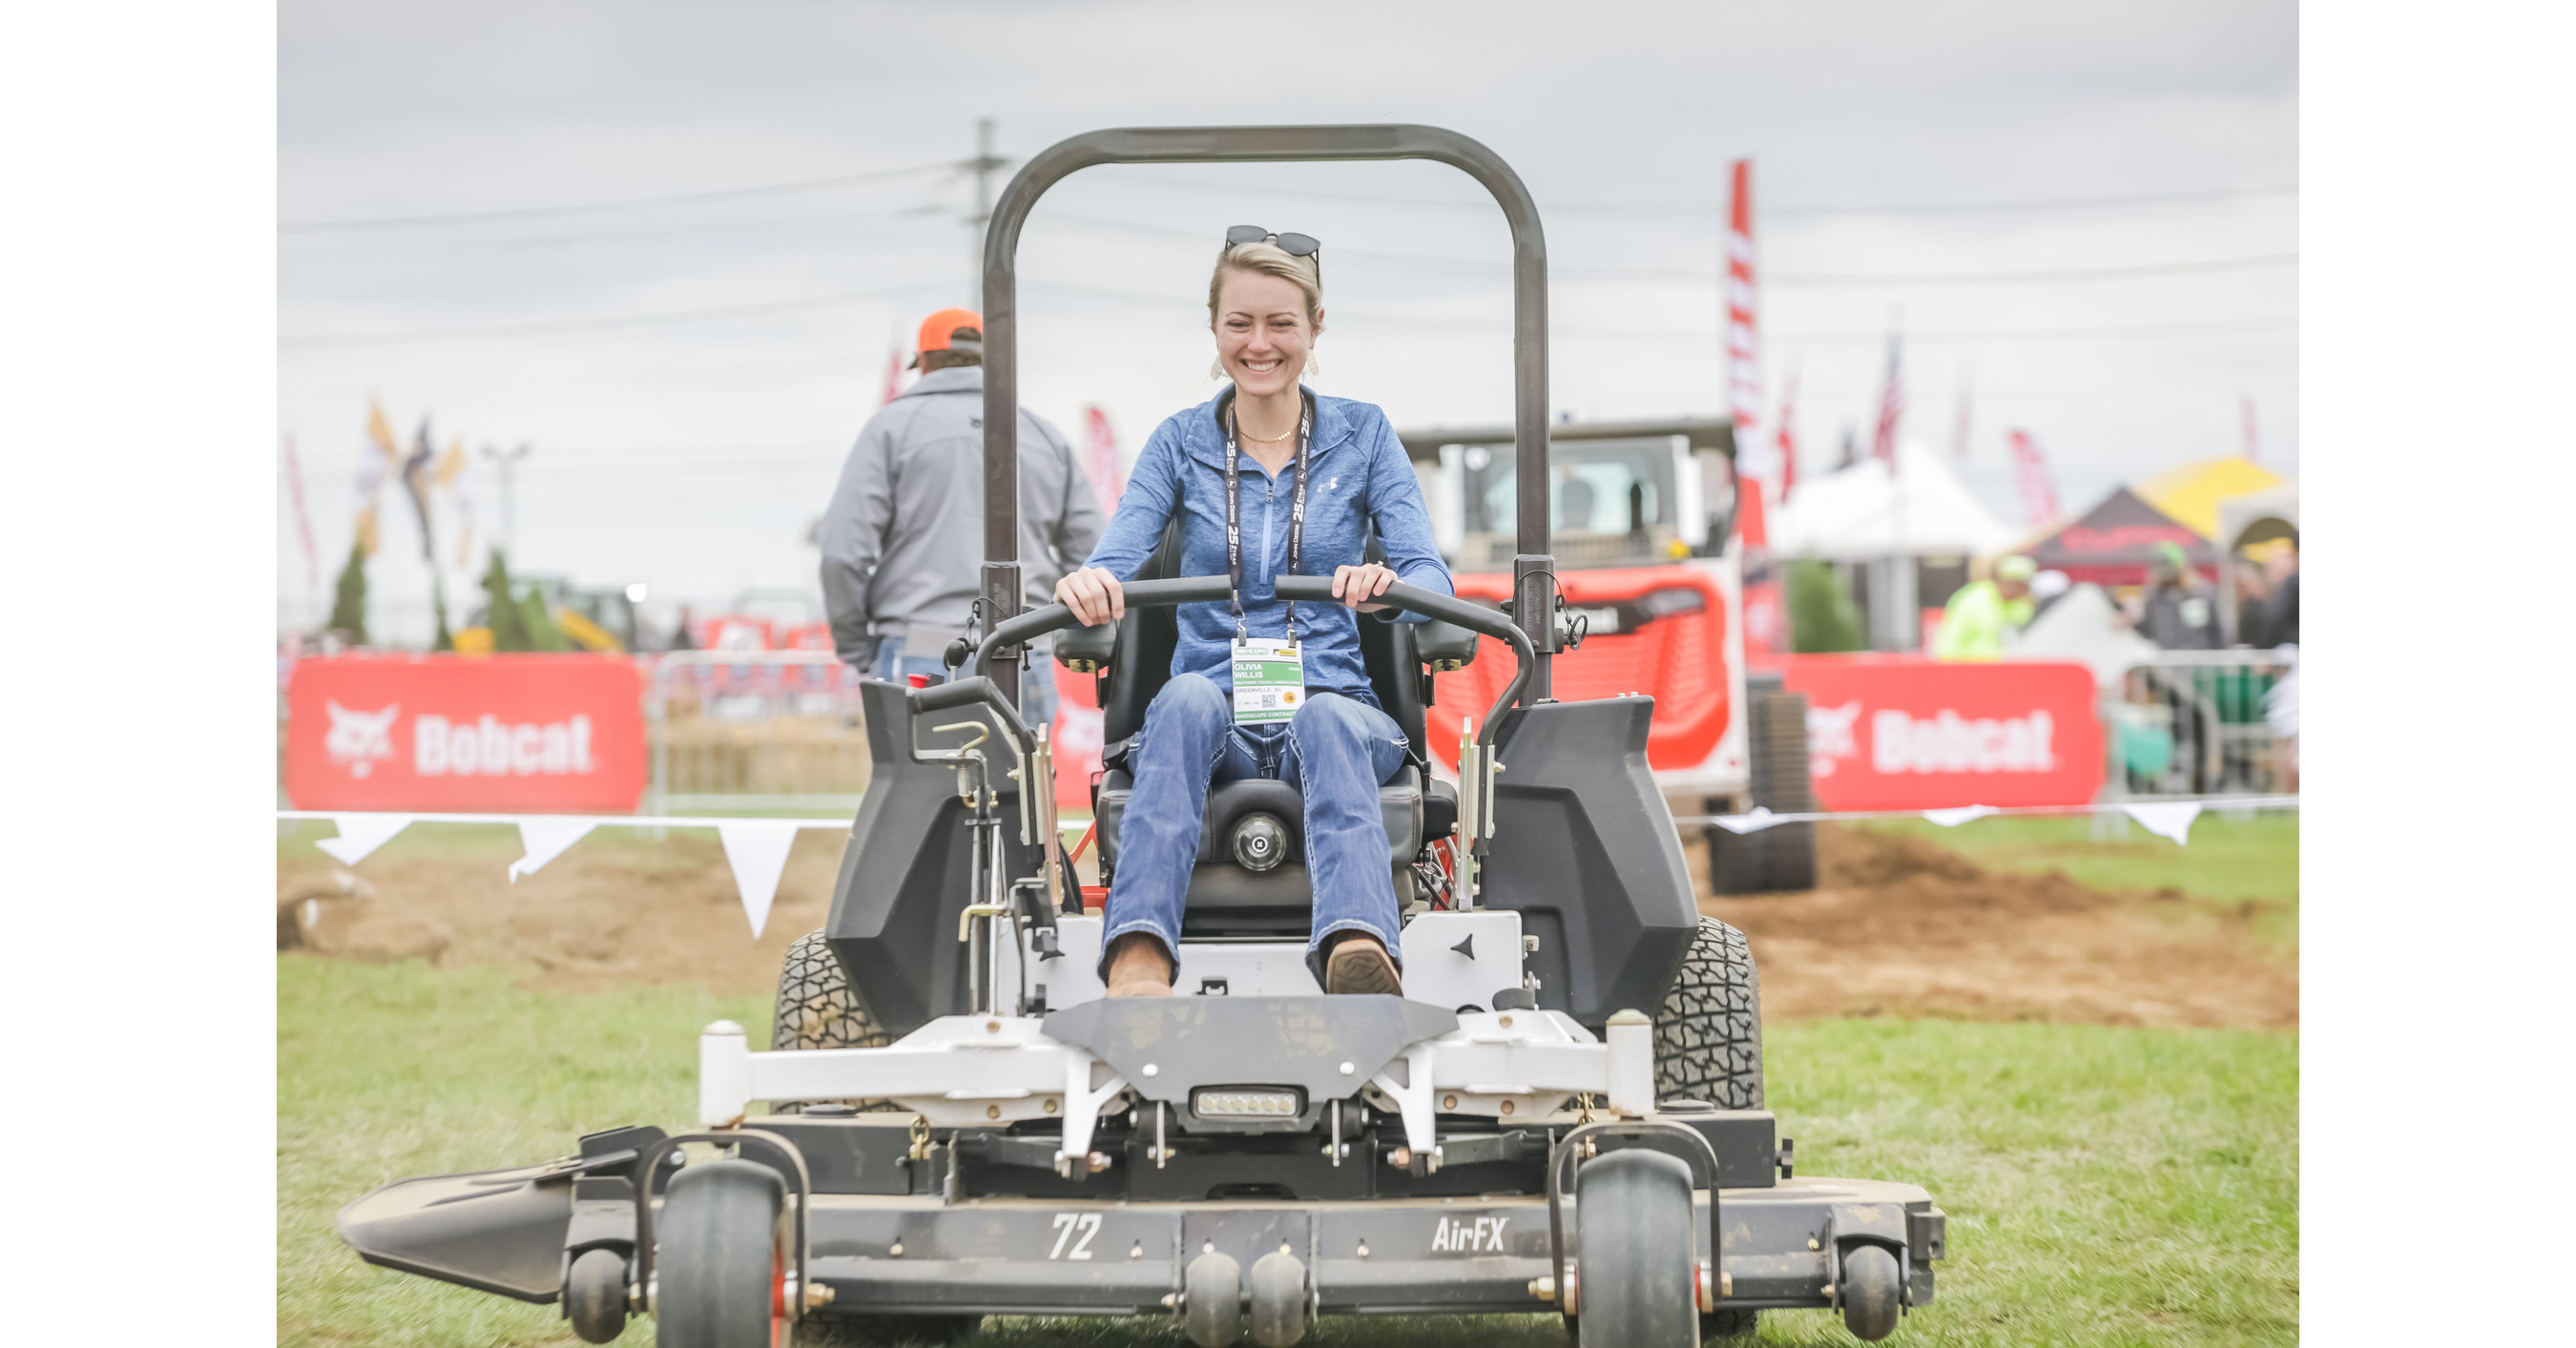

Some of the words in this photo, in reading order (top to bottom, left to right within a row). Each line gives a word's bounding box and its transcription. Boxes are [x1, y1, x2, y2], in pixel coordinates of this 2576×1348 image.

[1301, 418, 1309, 437] 25
[1226, 441, 1236, 457] 25
[1293, 503, 1304, 522] 25
[1228, 526, 1239, 545] 25
[415, 714, 591, 776] Bobcat
[1873, 709, 2052, 775] Bobcat
[1049, 1213, 1103, 1259] 72
[1431, 1216, 1507, 1251] AirFX
